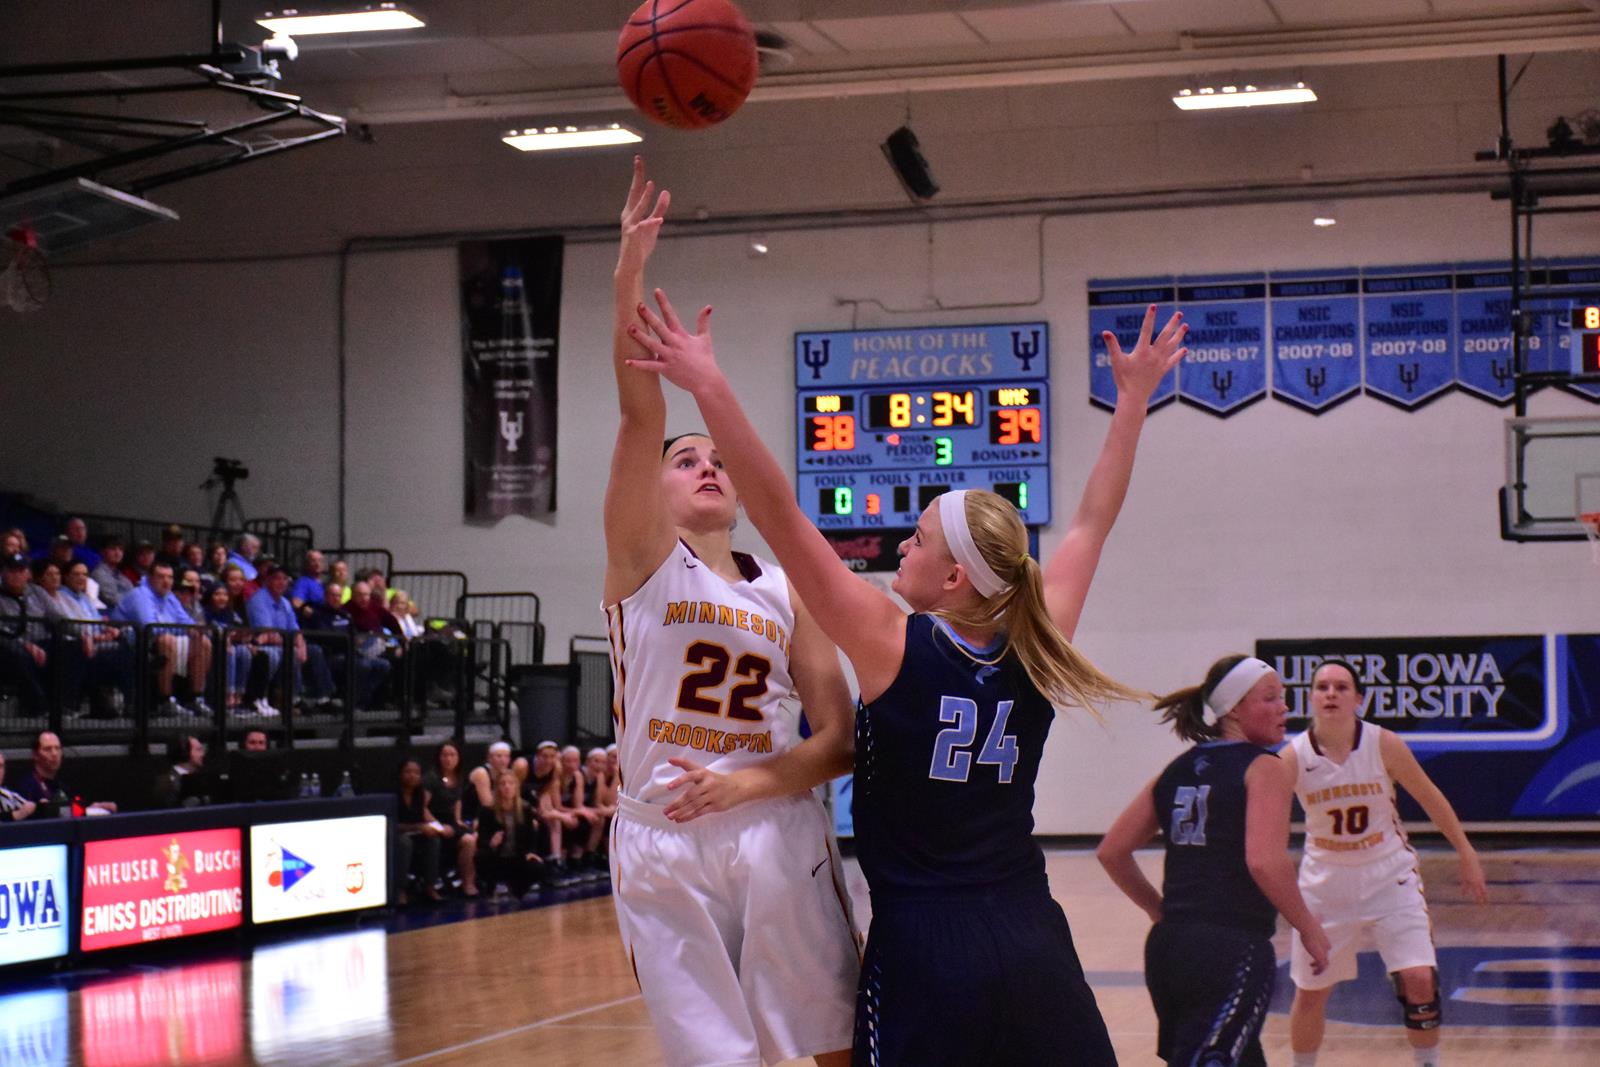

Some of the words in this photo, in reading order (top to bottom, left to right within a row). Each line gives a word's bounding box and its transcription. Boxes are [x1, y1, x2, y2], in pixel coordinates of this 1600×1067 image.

[1298, 306, 1331, 322] NSIC
[1390, 302, 1424, 318] NSIC
[1276, 323, 1355, 341] CHAMPIONS
[1368, 319, 1448, 337] CHAMPIONS
[854, 335, 913, 352] HOME
[918, 334, 944, 349] OF
[952, 332, 988, 348] THE
[1277, 342, 1354, 360] 2007-08
[1371, 338, 1447, 356] 2007-08
[1185, 346, 1259, 363] 2006-07
[851, 351, 994, 380] PEACOCKS
[998, 388, 1029, 406] UMC
[889, 391, 975, 428] 8:34
[813, 415, 855, 450] 38
[998, 408, 1041, 445] 39
[827, 452, 873, 466] BONUS
[886, 443, 933, 456] PERIOD
[935, 437, 953, 466] 3
[972, 448, 1019, 462] BONUS
[815, 475, 856, 487] FOULS
[870, 472, 911, 485] FOULS
[919, 470, 966, 483] PLAYER
[988, 469, 1031, 481] FOULS
[835, 486, 853, 515] 0
[866, 493, 880, 515] 3
[1274, 653, 1391, 685] UPER
[1396, 652, 1504, 685] IOWA
[675, 639, 772, 722] 22
[929, 695, 1019, 784] 24
[1170, 784, 1211, 846] 21
[1326, 804, 1370, 836] 10
[84, 900, 136, 936] EMISS
[139, 886, 242, 928] DISTRIBUTING
